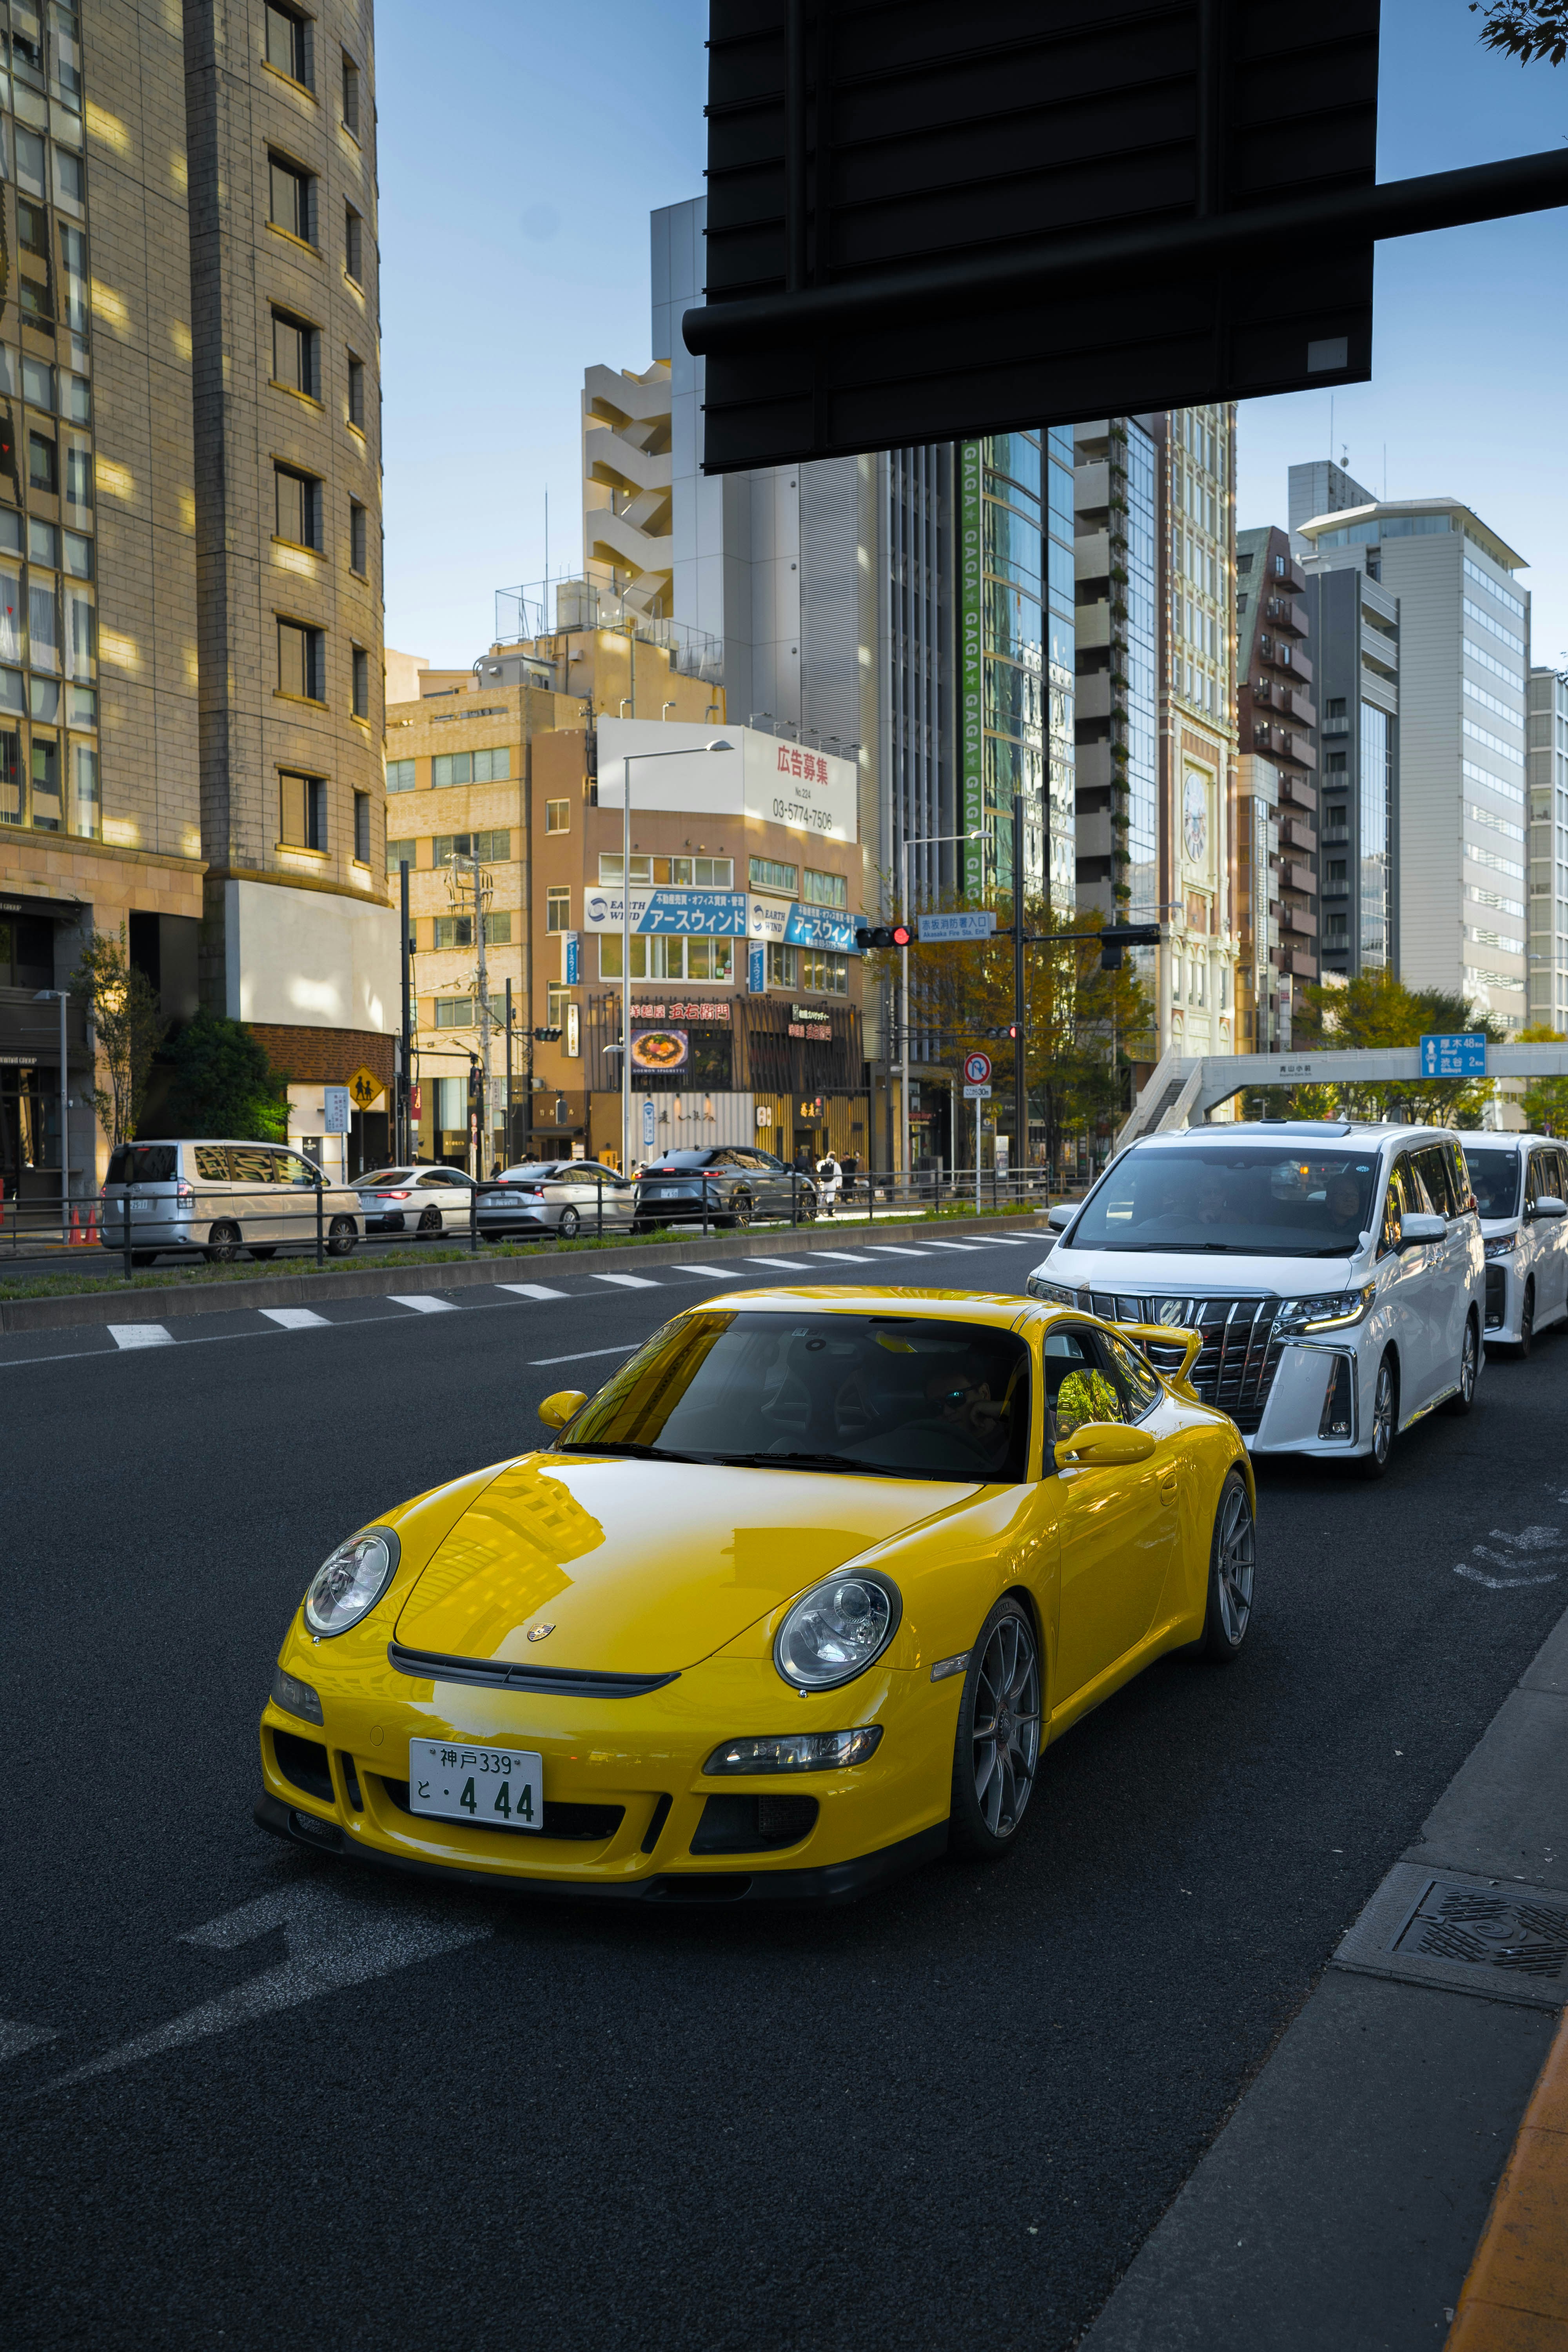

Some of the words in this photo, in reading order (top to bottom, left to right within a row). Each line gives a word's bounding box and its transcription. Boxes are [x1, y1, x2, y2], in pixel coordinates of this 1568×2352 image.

[964, 446, 976, 508] GAGA
[965, 530, 977, 590] GAGA
[965, 612, 978, 672] GAGA
[966, 693, 978, 753] GAGA
[777, 745, 828, 786] 広告募集
[795, 787, 811, 799] No.224
[773, 798, 832, 830] 03-5774-7506
[610, 901, 646, 910] EATH
[765, 909, 786, 921] EARTH
[650, 909, 744, 933] アースウィンド
[766, 922, 782, 933] WIND
[795, 916, 857, 944] アースウィンド
[922, 917, 985, 930] 赤坂消防署入口
[669, 1003, 730, 1020] 五右衛門
[1440, 1039, 1462, 1049] 厚木
[1441, 1057, 1463, 1068] 渋谷
